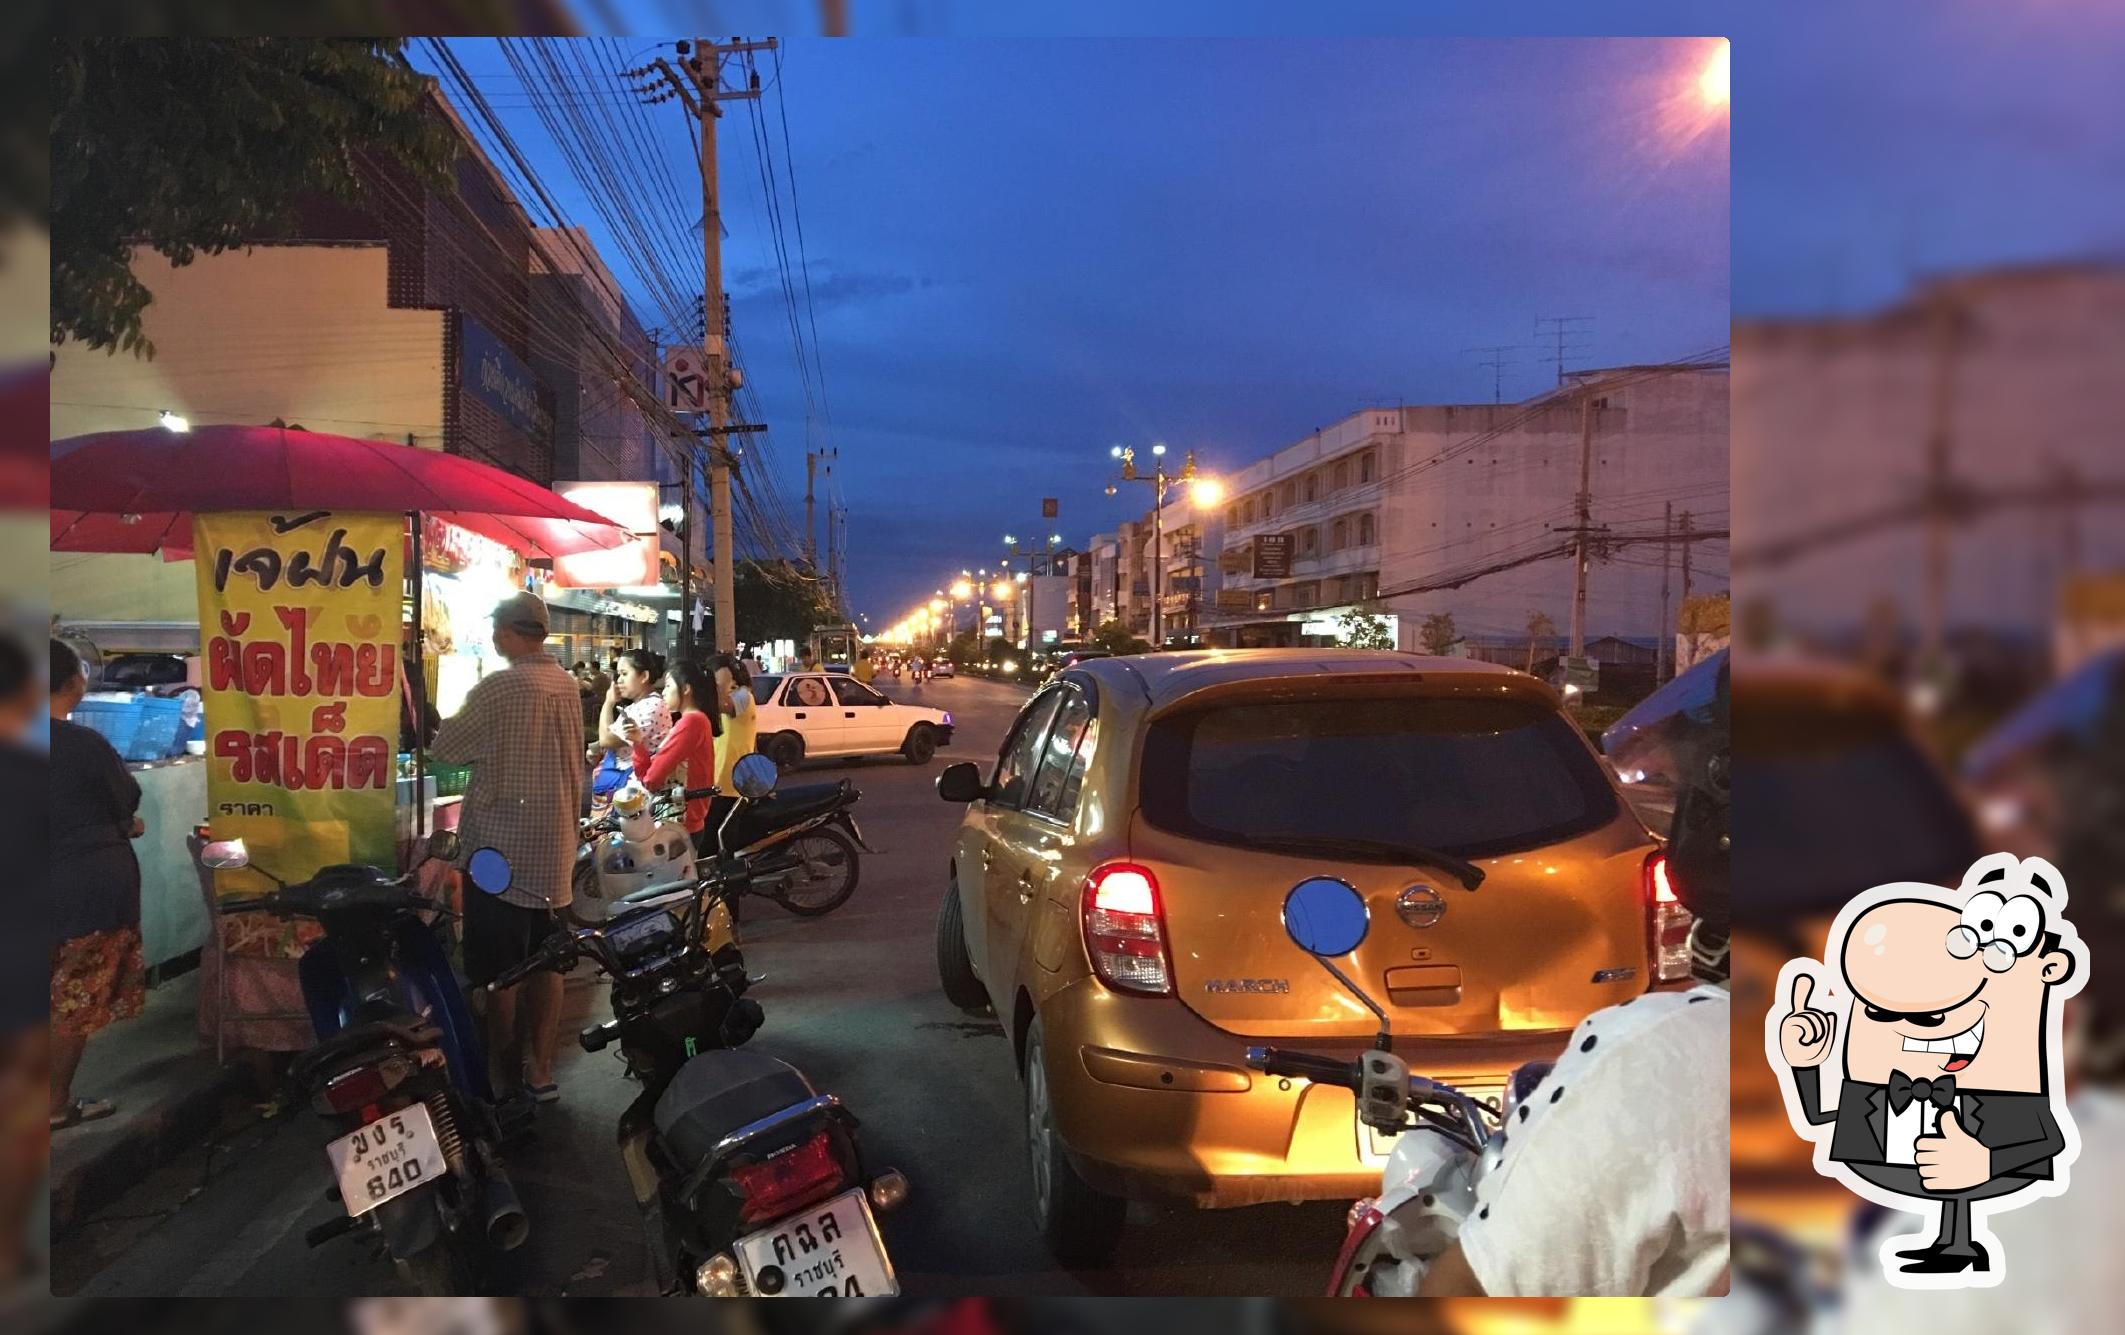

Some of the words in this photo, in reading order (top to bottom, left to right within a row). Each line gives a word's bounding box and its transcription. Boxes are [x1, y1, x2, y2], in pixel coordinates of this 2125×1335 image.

[208, 606, 396, 697] ผัดไทย
[214, 701, 389, 791] รสเด็ด
[219, 802, 274, 817] ราคา
[1205, 979, 1289, 993] MARCH
[366, 1158, 422, 1201] 640
[794, 1249, 844, 1287] ราชบุรี
